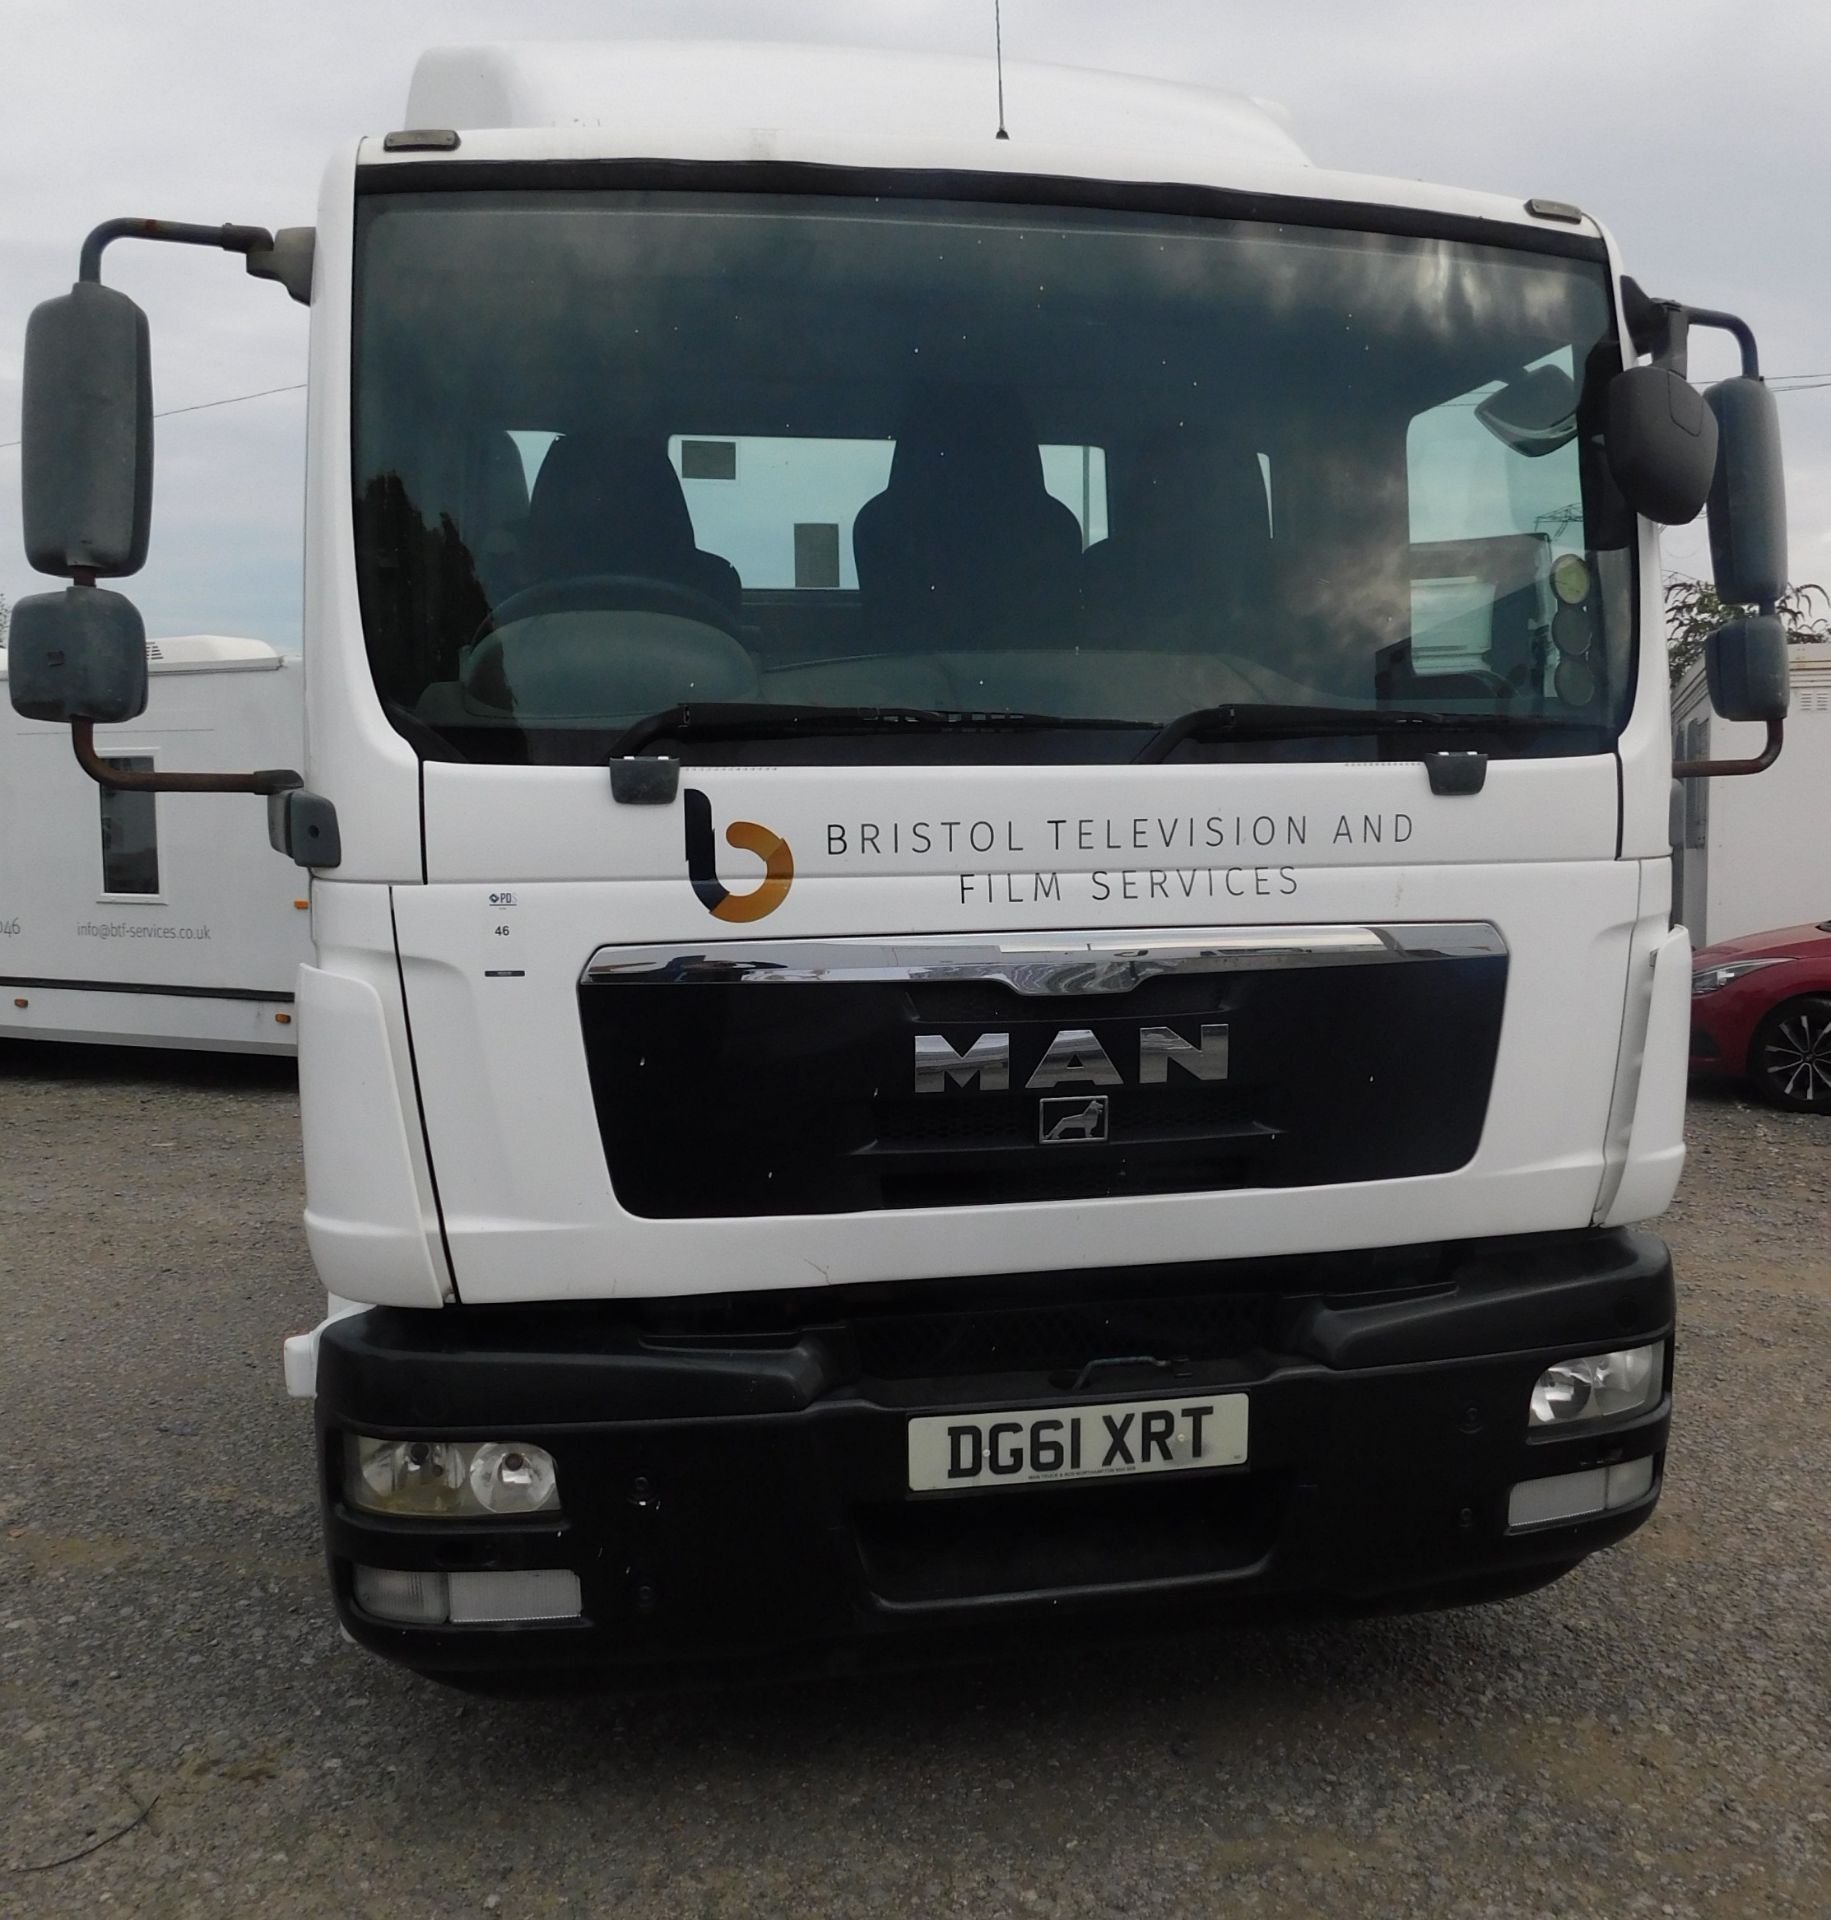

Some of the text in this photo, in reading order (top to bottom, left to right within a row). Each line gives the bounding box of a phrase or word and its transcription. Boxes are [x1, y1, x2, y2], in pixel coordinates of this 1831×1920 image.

[827, 813, 1414, 856] BRISTOL TELEVISION AND
[959, 866, 1299, 905] FILM SERVICES
[77, 921, 212, 940] info@btf-services.co.uk
[494, 925, 510, 936] 46
[914, 1023, 1229, 1093] MAN
[947, 1406, 1214, 1479] DG61 XRT
